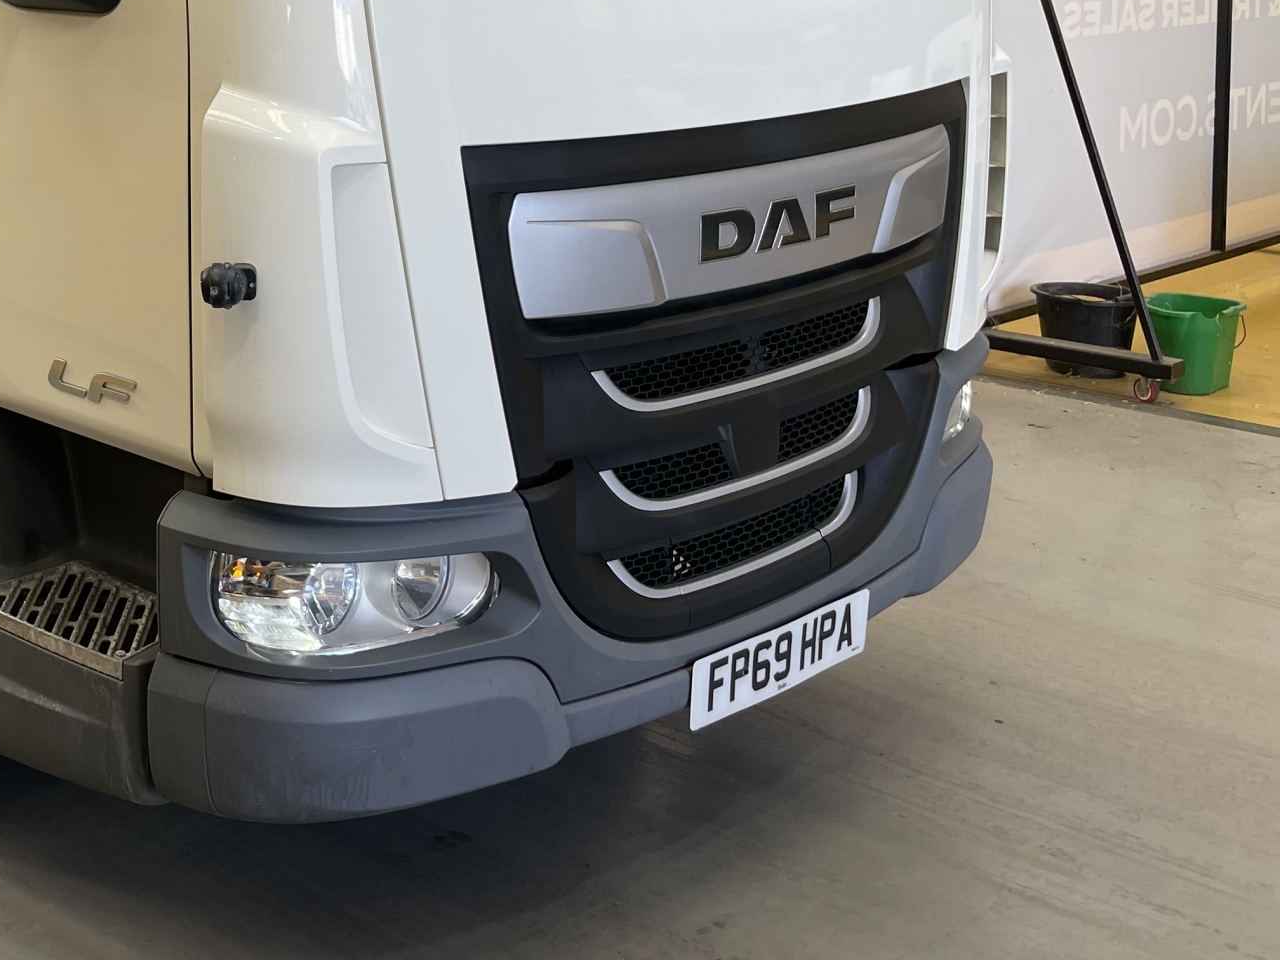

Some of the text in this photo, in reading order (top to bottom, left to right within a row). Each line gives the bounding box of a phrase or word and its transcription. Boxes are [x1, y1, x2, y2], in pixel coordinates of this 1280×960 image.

[698, 183, 857, 264] DAF
[47, 357, 137, 404] LF
[707, 602, 853, 713] FP69 HPA
